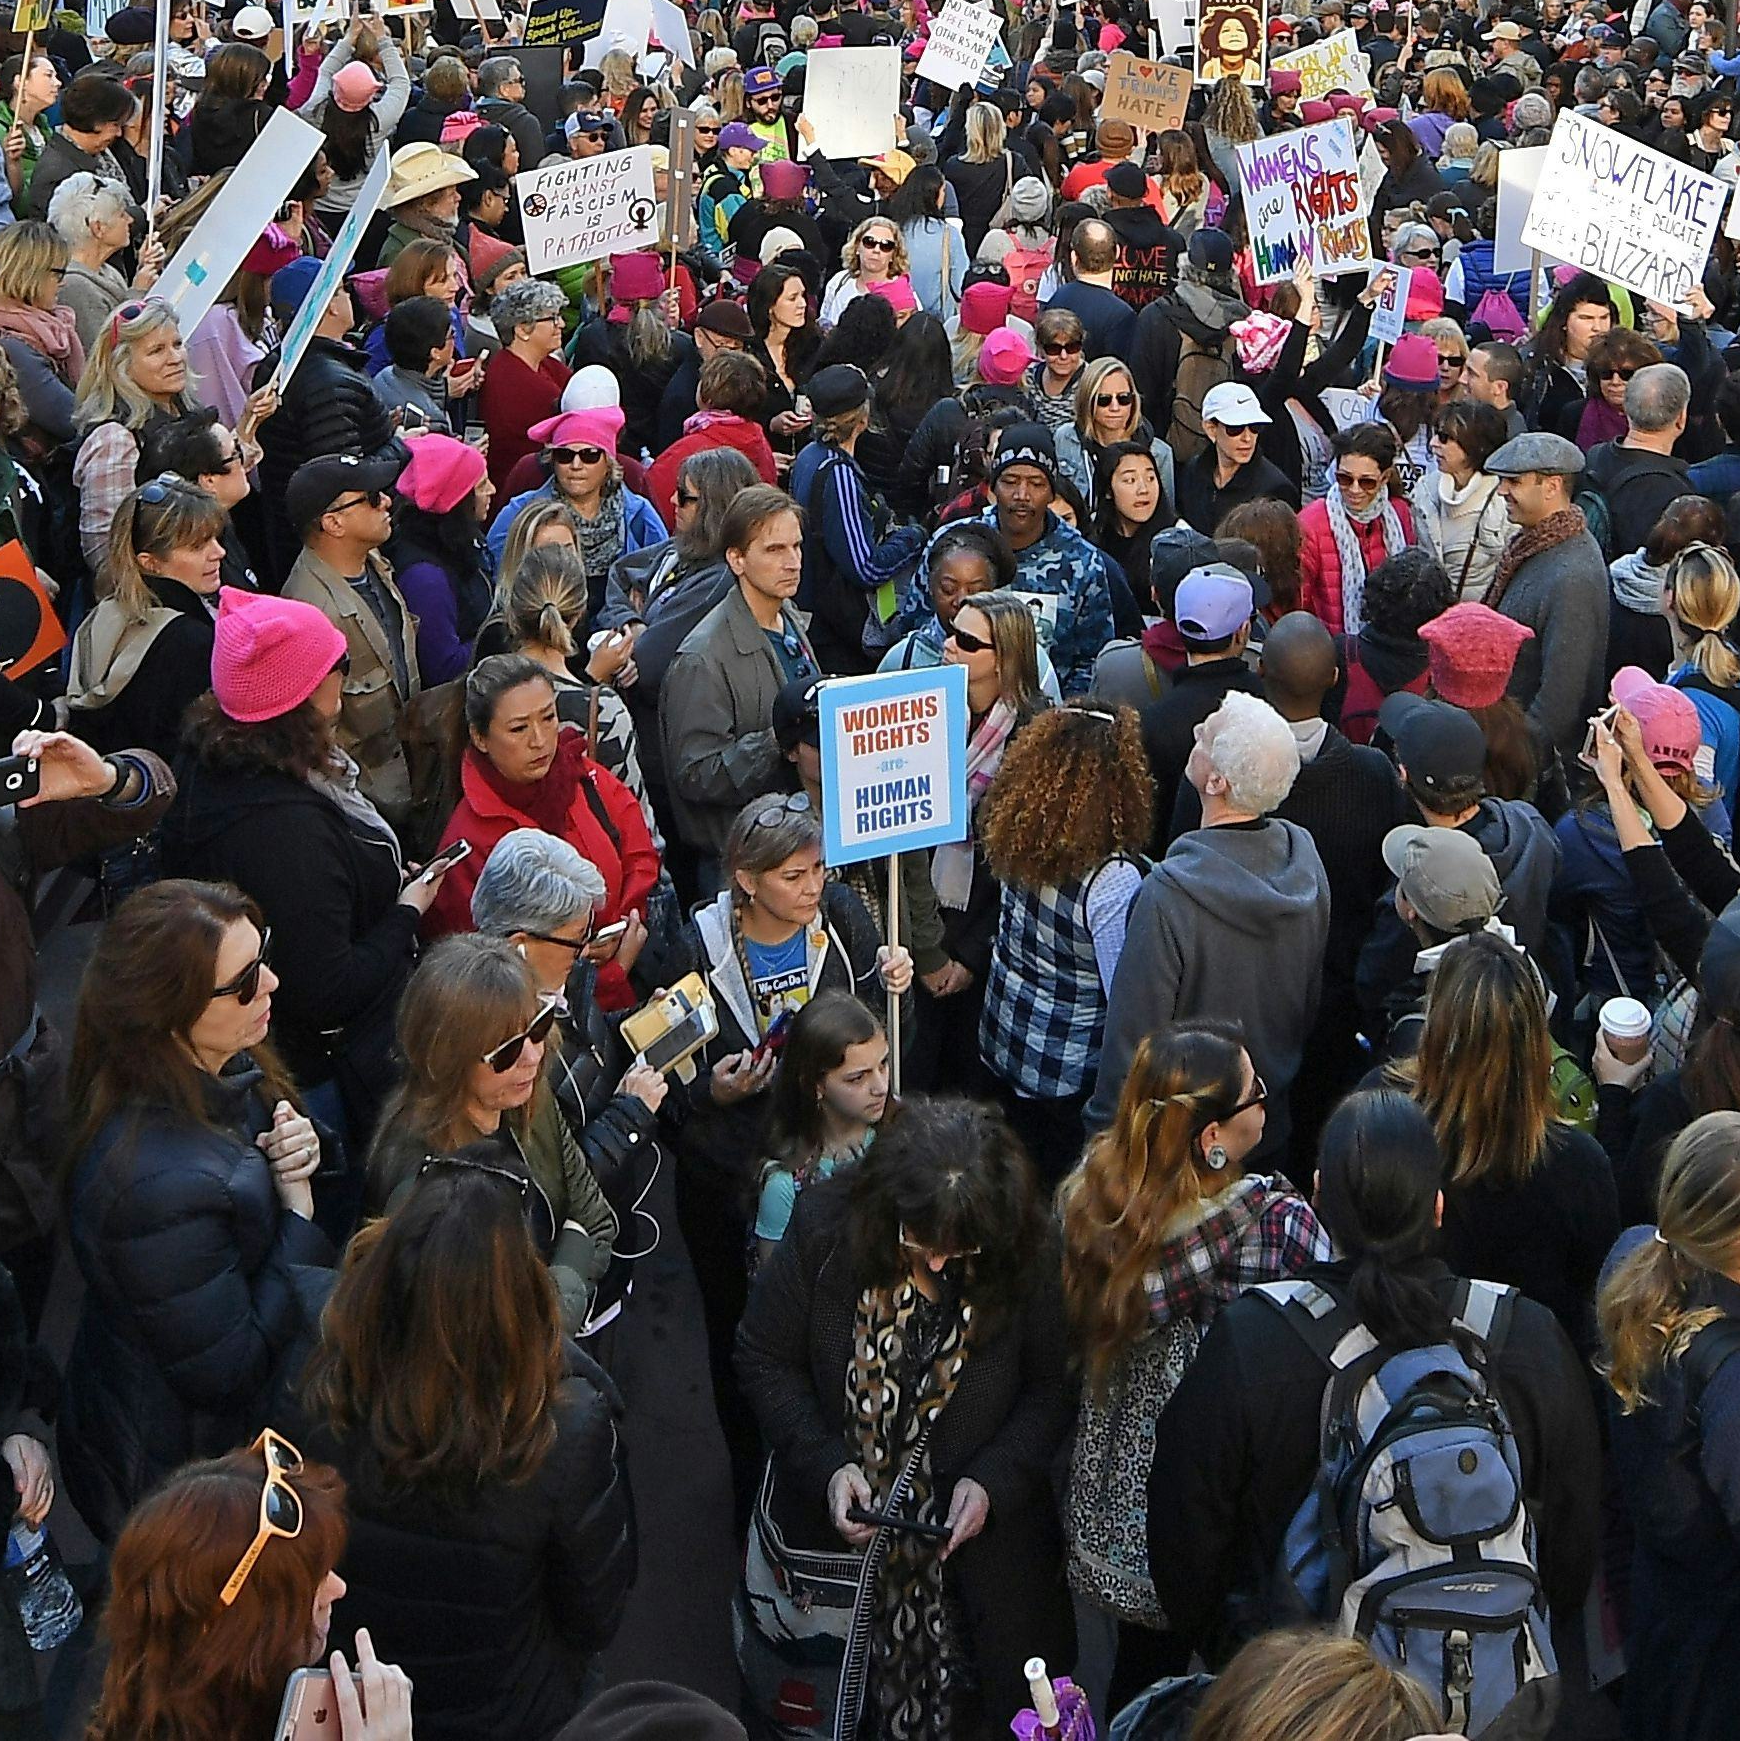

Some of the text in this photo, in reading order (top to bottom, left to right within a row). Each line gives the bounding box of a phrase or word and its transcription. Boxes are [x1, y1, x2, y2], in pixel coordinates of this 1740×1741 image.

[525, 25, 556, 40] Speak
[529, 12, 558, 27] Stand
[935, 25, 970, 48] OTHERS
[986, 18, 998, 30] IS
[1117, 94, 1164, 118] HATE
[536, 155, 633, 192] FIGHTING
[1236, 132, 1322, 196] WOMEN'S
[1561, 122, 1714, 228] SNOWFLAKE
[546, 188, 637, 223] FASCISM
[551, 174, 624, 203] AGAINST
[1258, 170, 1359, 229] are RIGHTS
[586, 213, 602, 227] IS
[544, 222, 635, 259] PATRIOTIC
[1113, 244, 1167, 269] LOVE
[1253, 227, 1314, 280] HUMAN
[1115, 269, 1168, 285] NOT HATE
[1580, 222, 1696, 305] BLIZZARD
[842, 695, 938, 734] WOMENS
[852, 721, 931, 756] RIGHTS
[855, 775, 932, 809] HUMAN
[856, 799, 933, 834] RIGHTS
[758, 974, 801, 994] We Can Do
